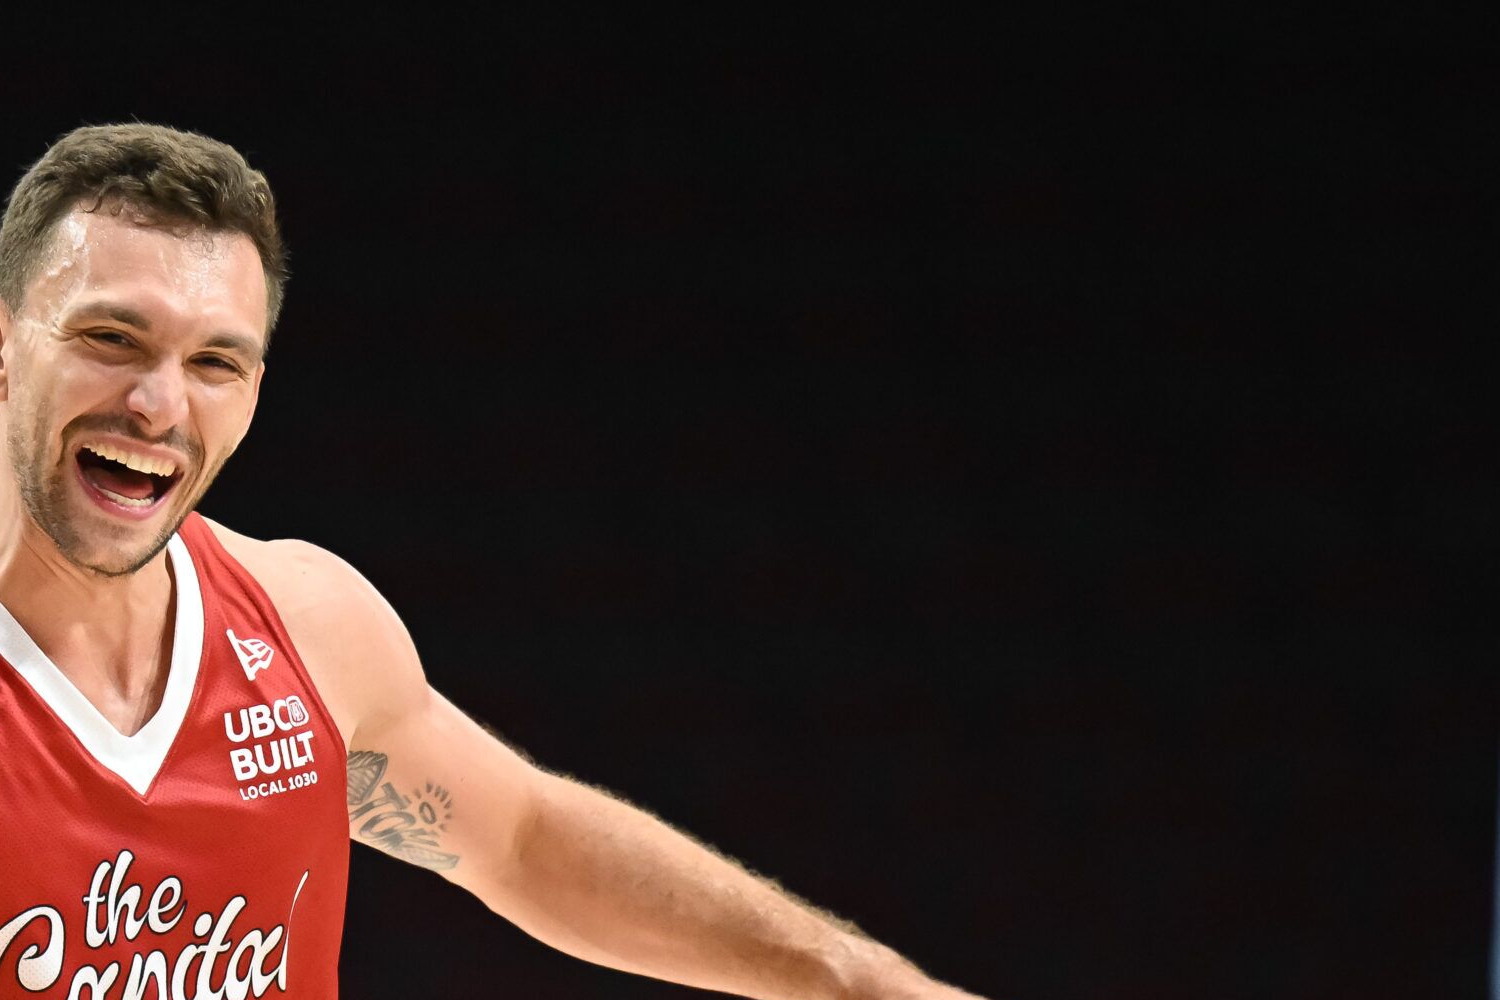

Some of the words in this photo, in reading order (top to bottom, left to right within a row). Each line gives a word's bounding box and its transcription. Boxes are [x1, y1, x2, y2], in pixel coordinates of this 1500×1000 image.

[230, 730, 315, 782] BUILT
[239, 779, 287, 801] LOCAL
[288, 770, 319, 791] 1030
[83, 850, 187, 949] the
